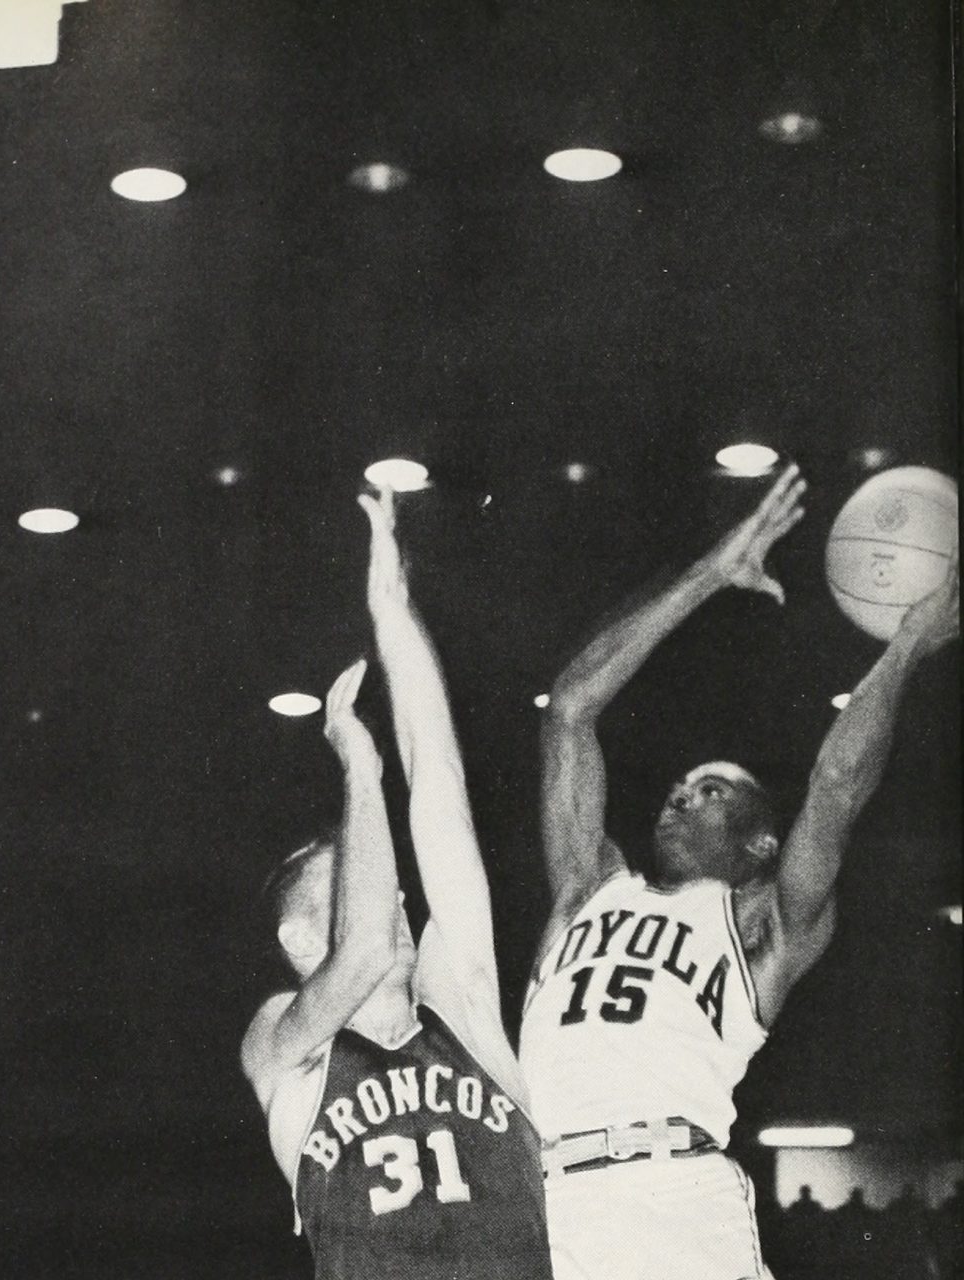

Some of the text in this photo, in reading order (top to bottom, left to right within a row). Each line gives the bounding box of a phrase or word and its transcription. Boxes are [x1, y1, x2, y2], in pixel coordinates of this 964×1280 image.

[559, 964, 655, 1026] 15
[302, 1064, 517, 1172] BRONCOS
[362, 1129, 472, 1216] 31
